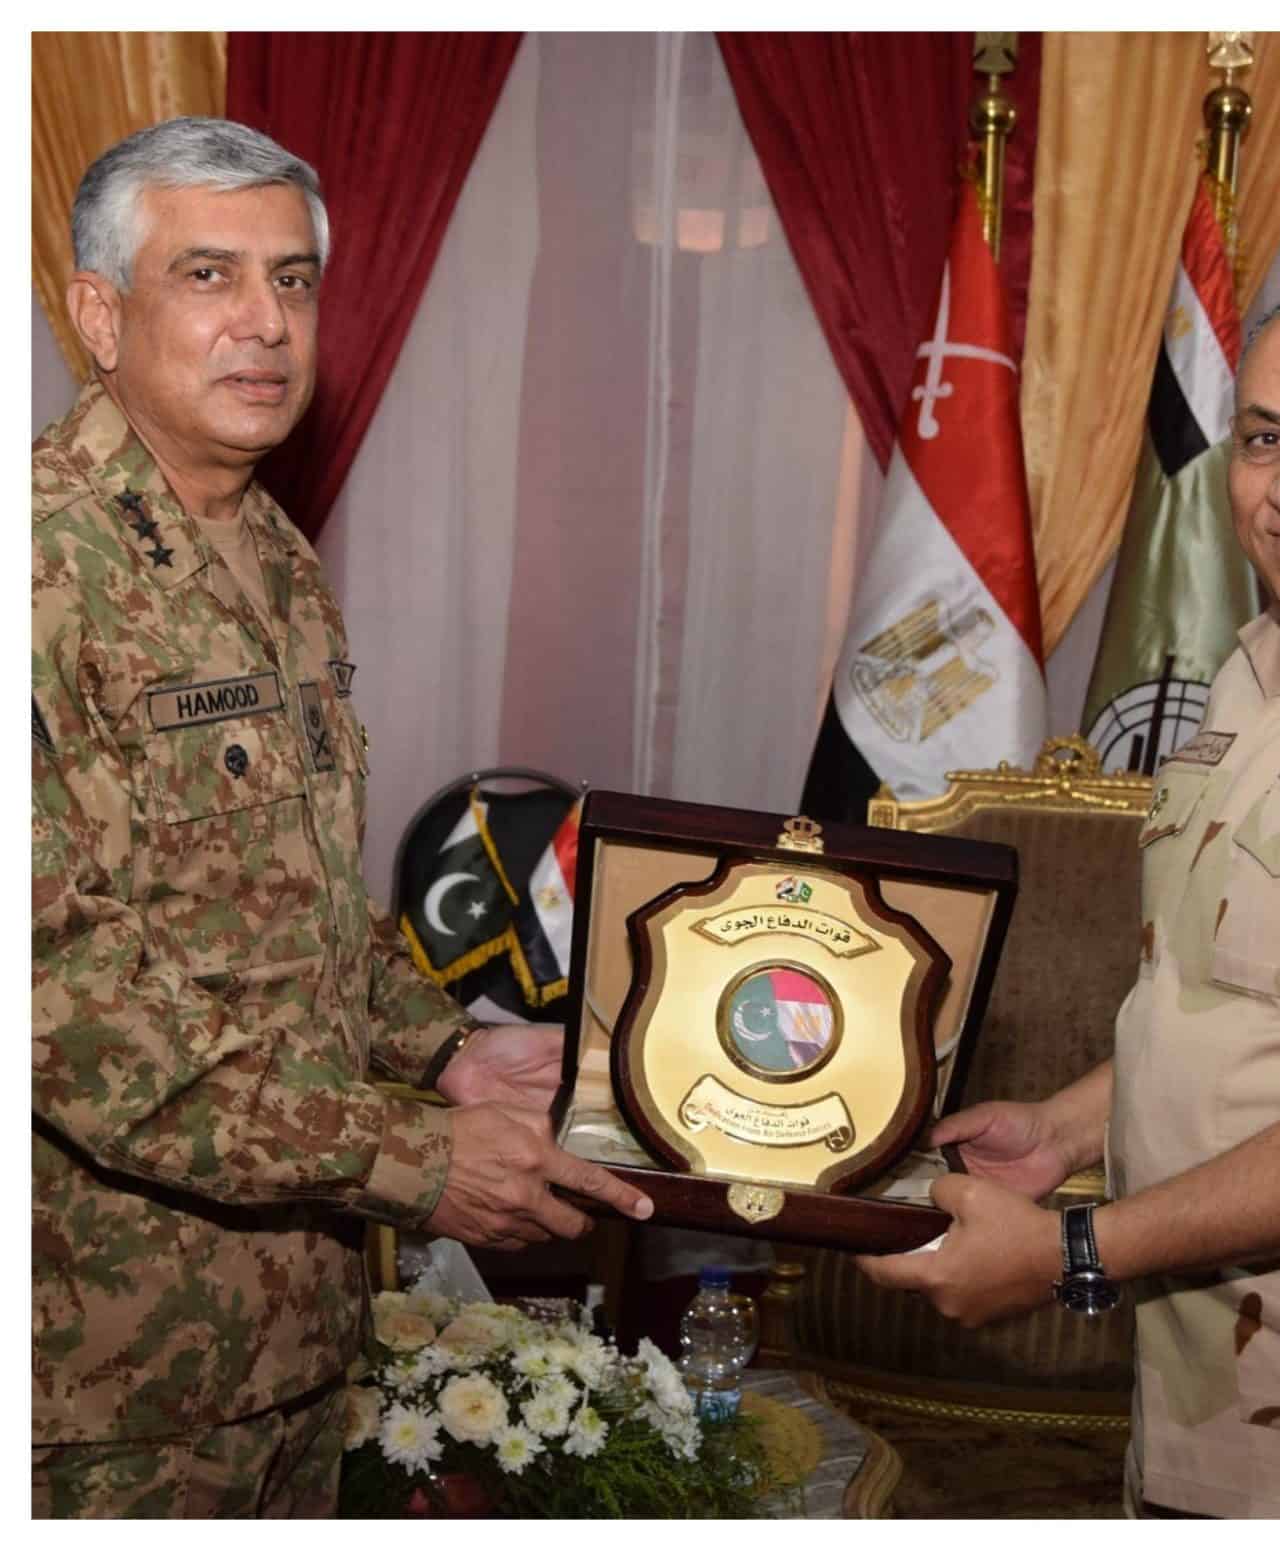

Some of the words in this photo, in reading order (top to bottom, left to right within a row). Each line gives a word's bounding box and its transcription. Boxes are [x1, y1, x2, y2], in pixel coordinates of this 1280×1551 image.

[176, 684, 259, 719] HAMOOD
[719, 913, 765, 933] الجوى
[766, 913, 813, 930] الدفاع
[814, 921, 851, 944] قوات
